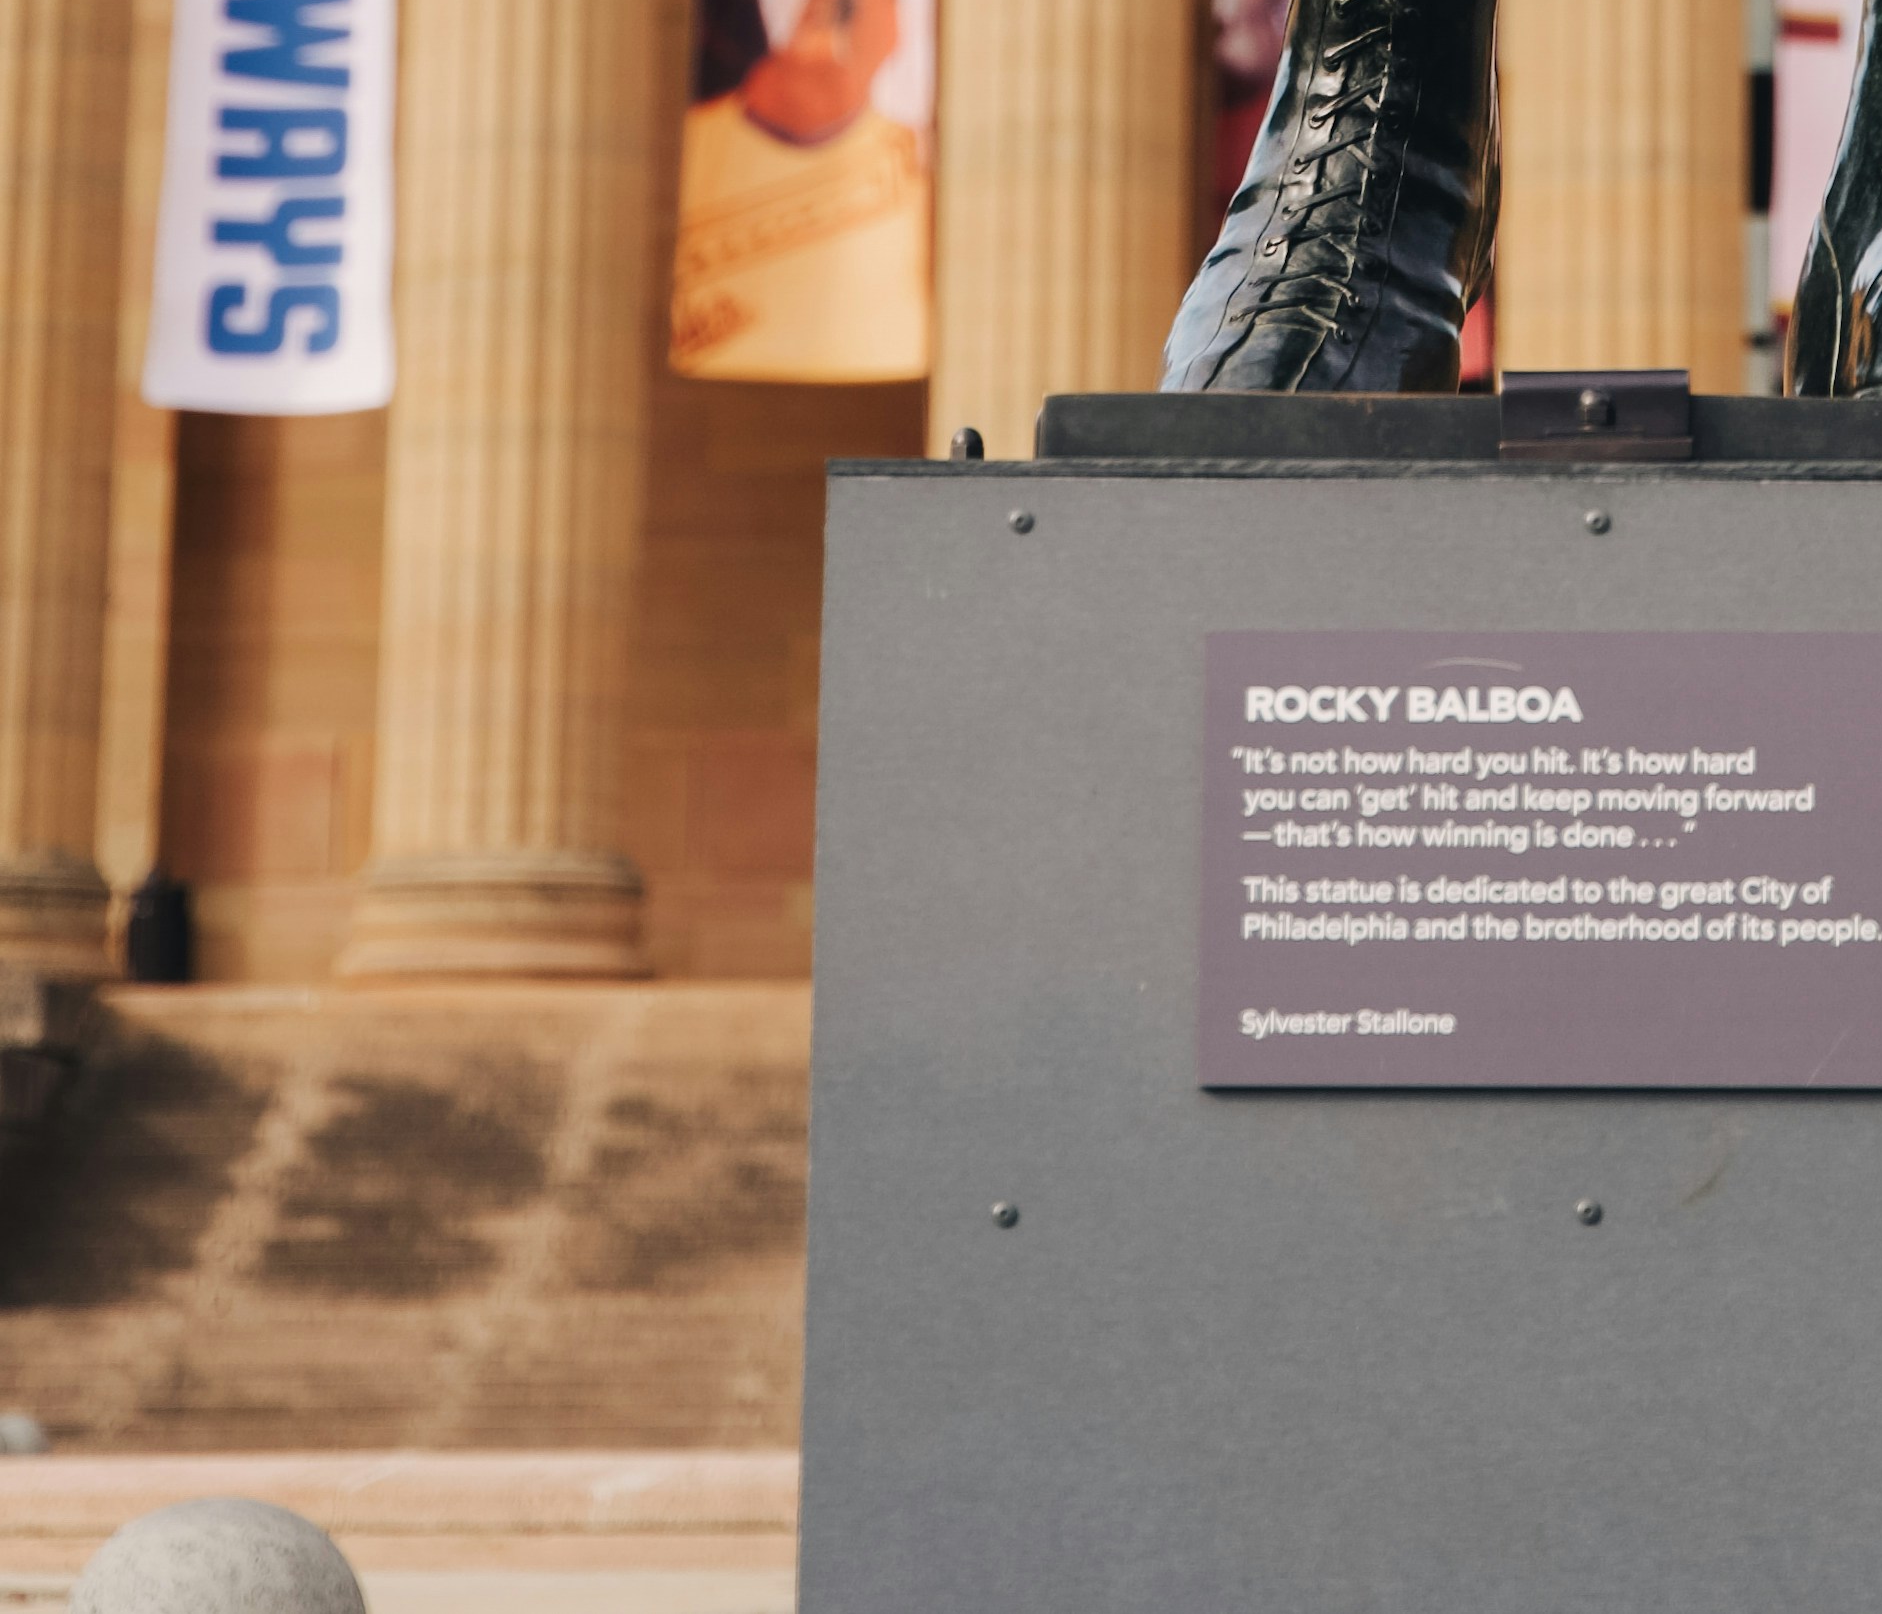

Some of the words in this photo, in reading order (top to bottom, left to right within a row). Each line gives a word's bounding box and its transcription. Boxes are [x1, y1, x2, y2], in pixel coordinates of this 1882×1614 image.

[1244, 683, 1402, 725] ROCKY
[1405, 684, 1585, 725] BALBOA
[1288, 747, 1340, 776] not
[1341, 745, 1406, 776] how
[1405, 745, 1474, 776] hard
[1473, 750, 1530, 783] you
[1530, 744, 1577, 777] hit.
[1579, 746, 1625, 777] It's
[1625, 746, 1690, 777] how
[1689, 745, 1758, 777] hard
[1241, 786, 1298, 819] you
[1297, 786, 1352, 813] can
[1419, 781, 1461, 813] hit
[1462, 781, 1520, 813] and
[1520, 782, 1595, 819] keep
[1595, 781, 1702, 820] moving
[1702, 780, 1817, 814] forward
[1355, 818, 1420, 849] how
[1419, 817, 1532, 856] winning
[1532, 817, 1560, 850] is
[1241, 873, 1303, 905] This
[1303, 877, 1396, 906] statue
[1397, 873, 1424, 905] is
[1423, 873, 1569, 906] dedicated
[1569, 877, 1606, 906] to
[1605, 874, 1658, 906] the
[1658, 877, 1737, 912] great
[1738, 874, 1799, 913] City
[1799, 874, 1834, 906] of
[1241, 910, 1411, 948] Philadelphia
[1412, 911, 1470, 942] and
[1469, 911, 1522, 943] the
[1522, 911, 1703, 943] brotherhood
[1704, 910, 1738, 943] of
[1739, 911, 1777, 943] its
[1239, 1007, 1354, 1042] Sylvester
[1355, 1007, 1458, 1037] Stallone
